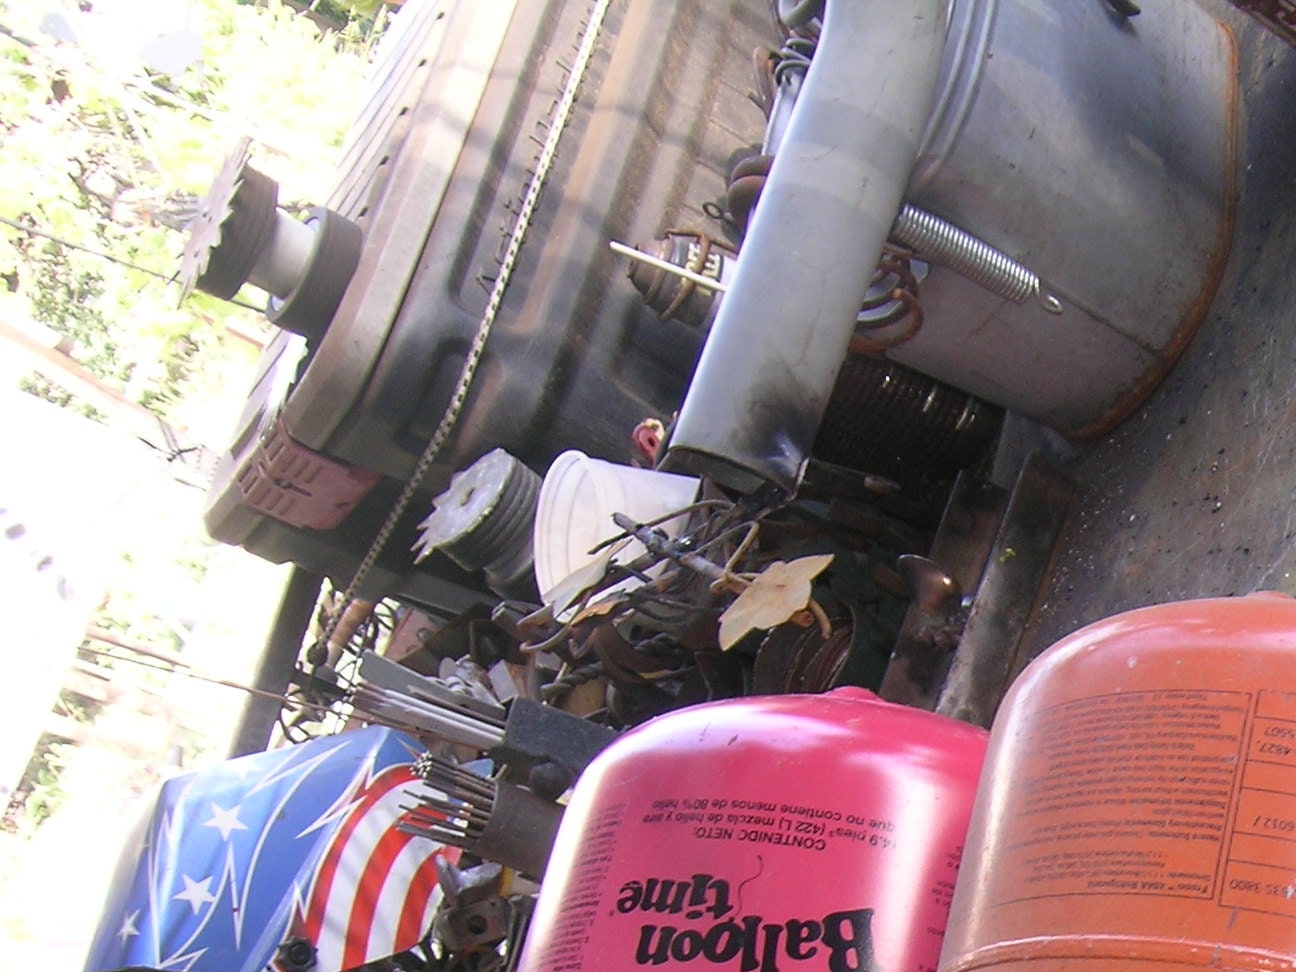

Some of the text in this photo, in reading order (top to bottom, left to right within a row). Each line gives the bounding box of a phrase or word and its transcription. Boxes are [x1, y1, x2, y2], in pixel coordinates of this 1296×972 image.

[680, 797, 708, 810] 80%
[710, 797, 728, 810] de
[730, 798, 777, 813] menos
[664, 810, 673, 822] y
[674, 811, 704, 824] helio
[707, 812, 724, 825] de
[724, 812, 775, 827] mezcla
[779, 801, 842, 823] contiene
[844, 812, 865, 827] no
[777, 815, 792, 829] L)
[794, 817, 826, 835] (422
[691, 826, 827, 851] CONTENIDO NETO:
[614, 873, 734, 919] time
